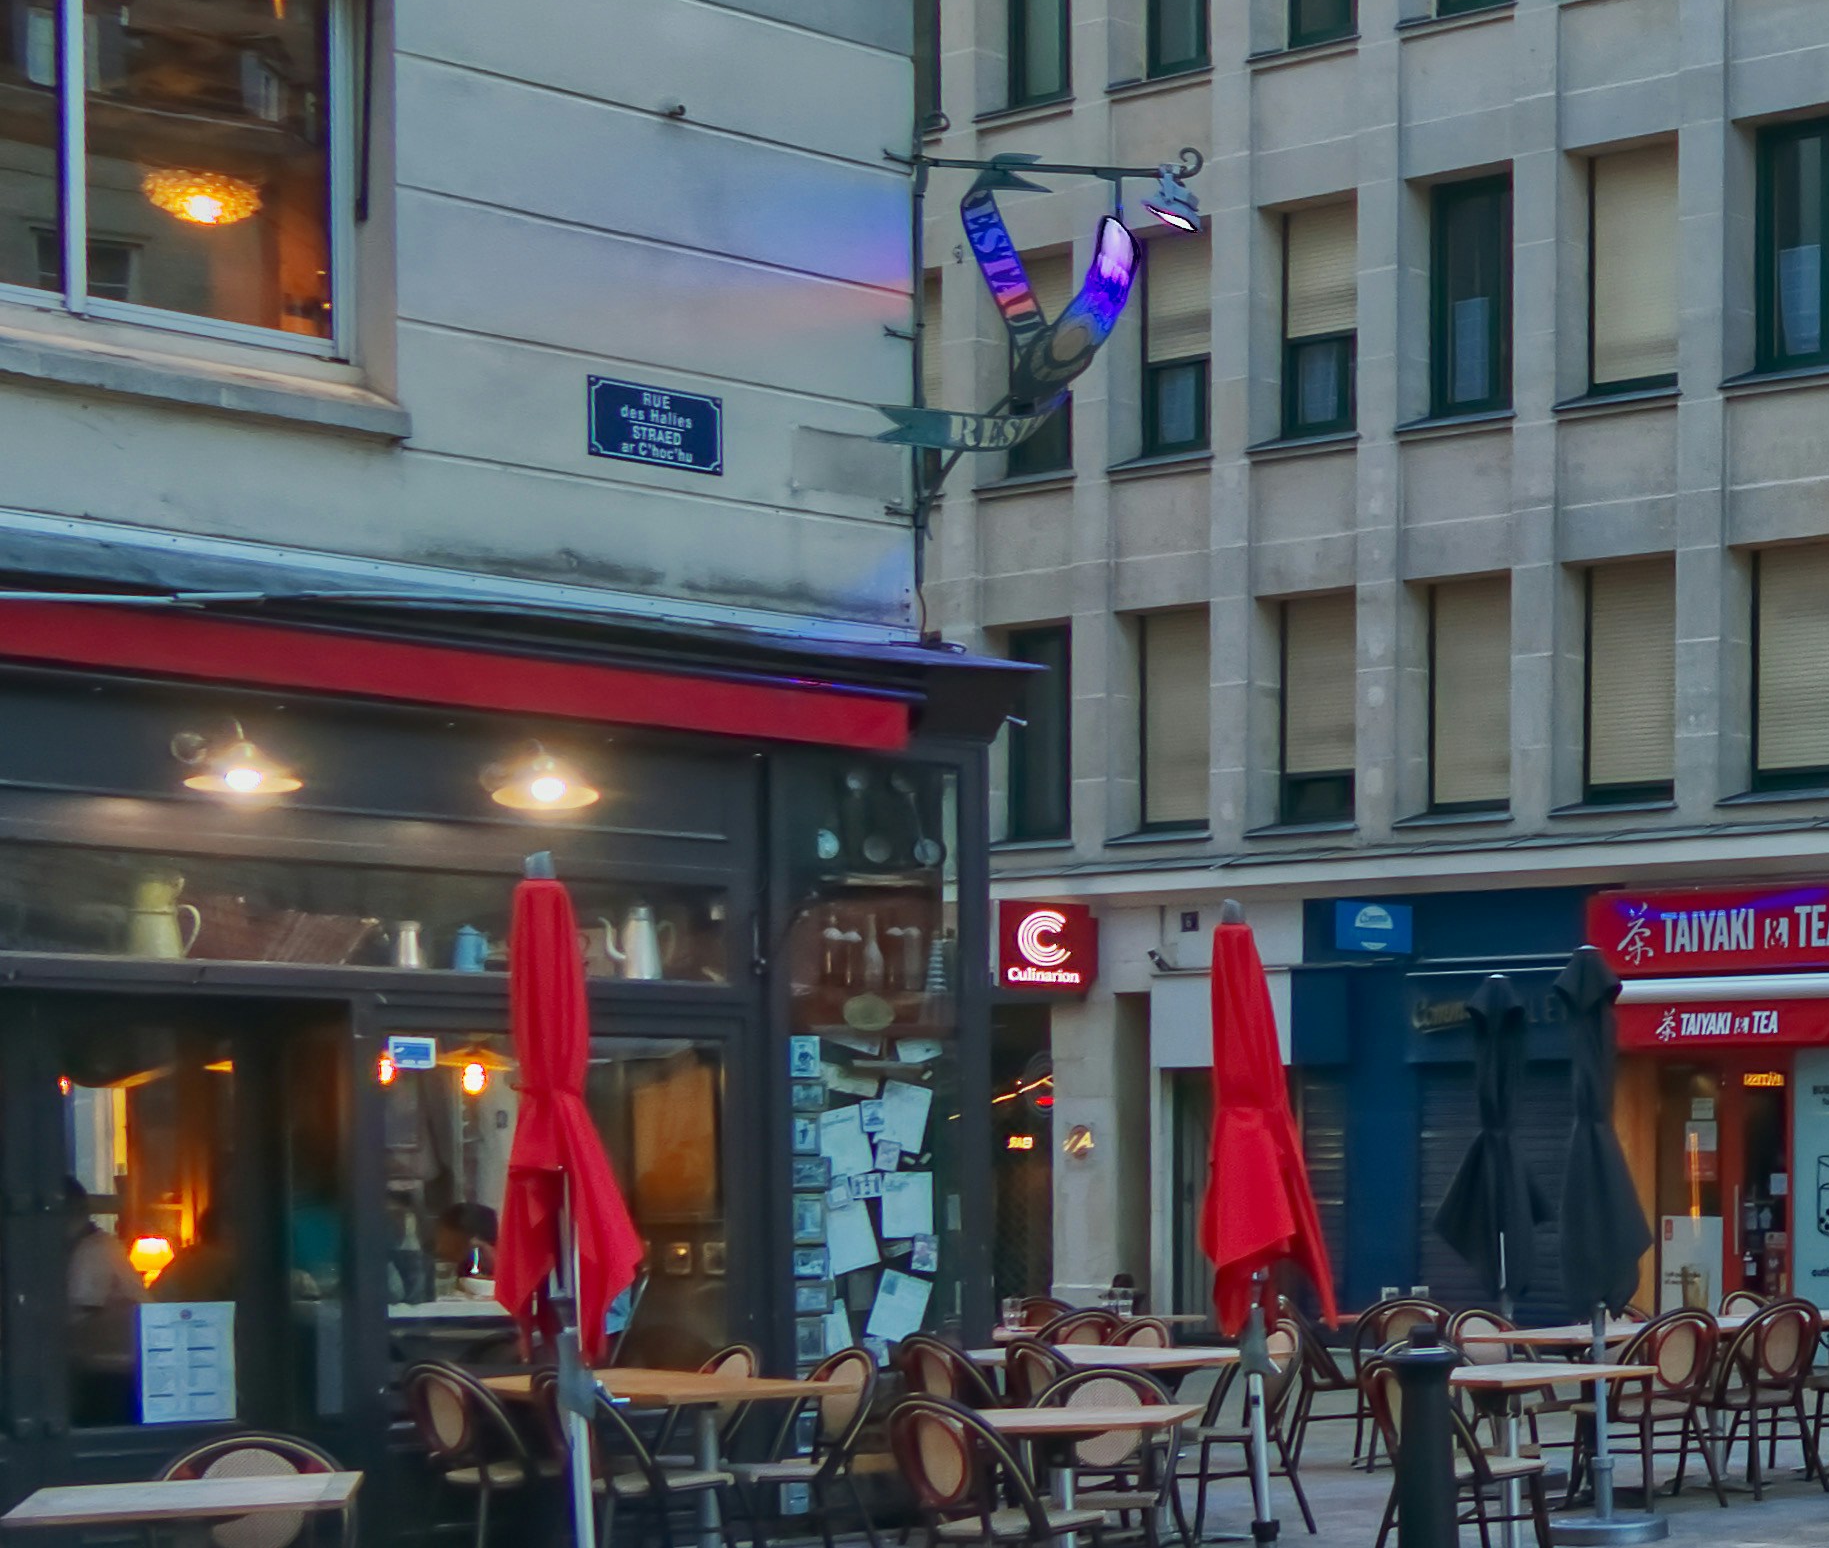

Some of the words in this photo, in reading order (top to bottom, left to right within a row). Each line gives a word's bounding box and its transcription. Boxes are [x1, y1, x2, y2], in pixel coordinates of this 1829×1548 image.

[642, 392, 671, 410] RUE
[620, 404, 645, 421] des
[650, 408, 693, 429] Halles
[632, 425, 682, 446] STRAED
[621, 441, 635, 454] ar
[638, 442, 693, 463] C'hoc'hu
[1661, 908, 1755, 954] TAIYAKI
[1007, 967, 1080, 985] Culinarion
[1680, 1012, 1732, 1037] TAIYAKI
[1752, 1010, 1779, 1034] TEA
